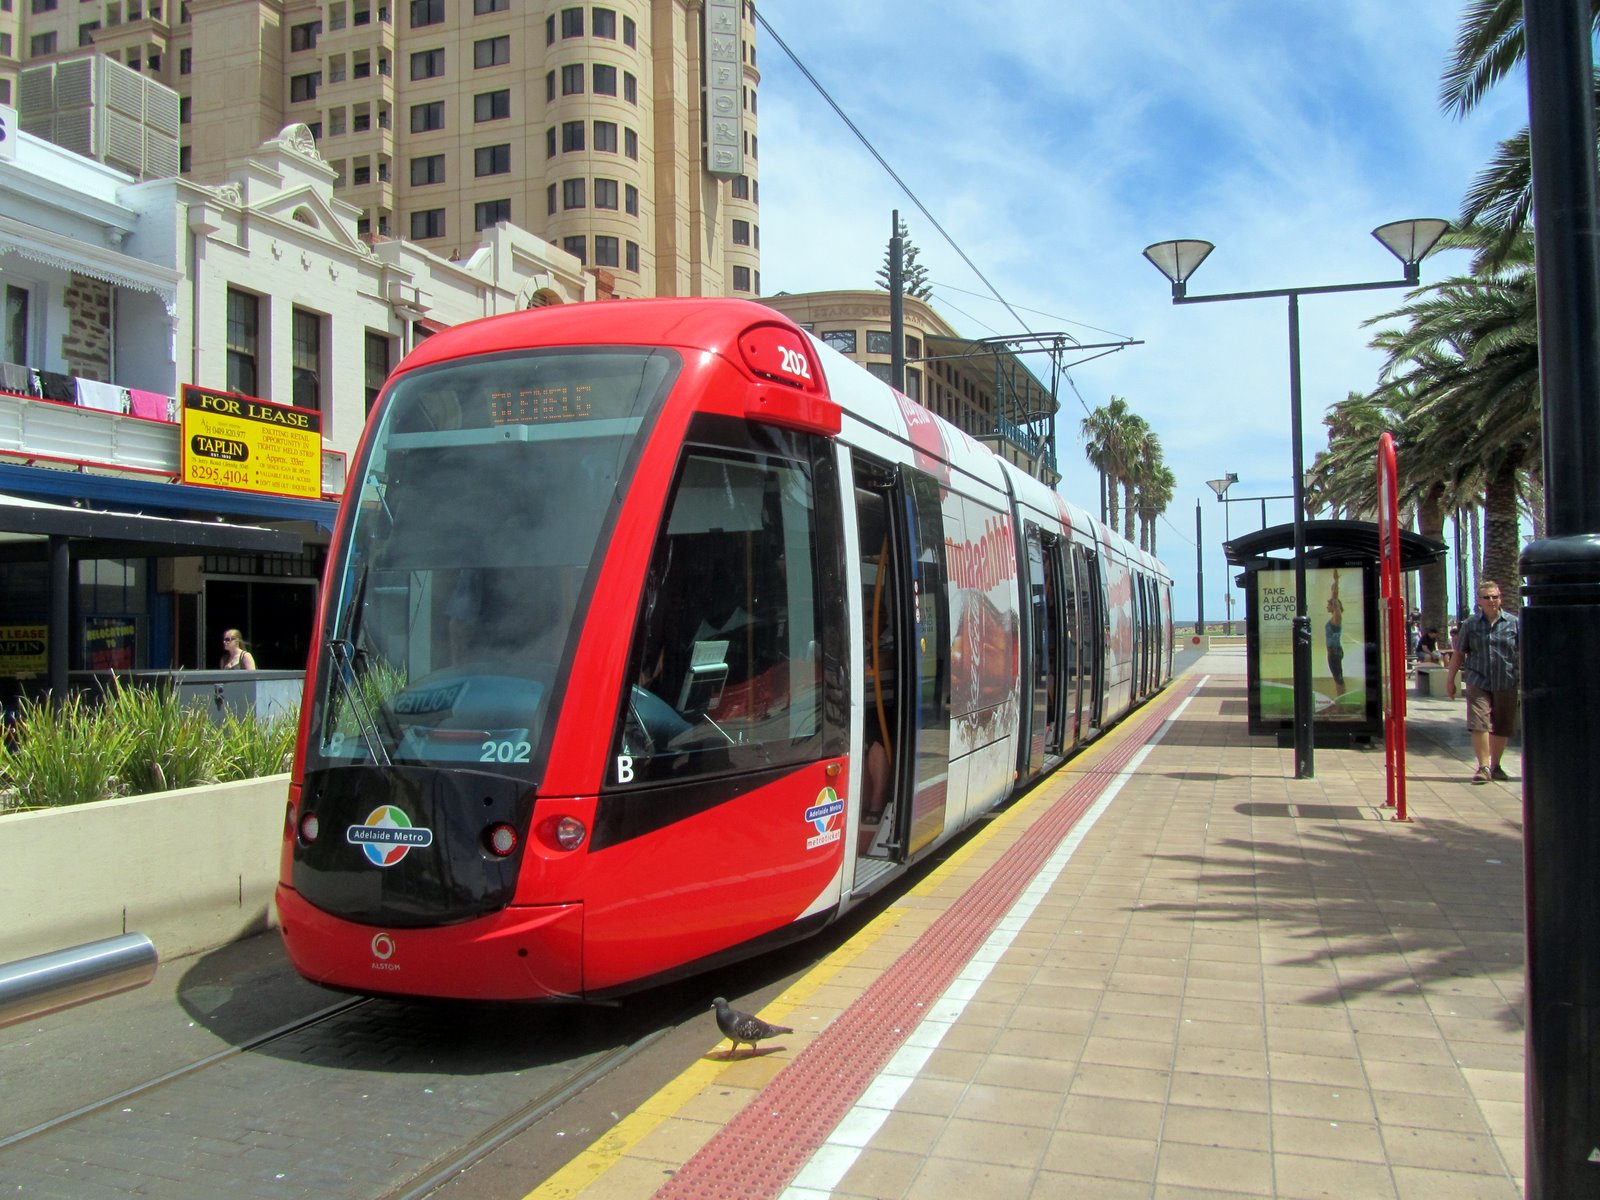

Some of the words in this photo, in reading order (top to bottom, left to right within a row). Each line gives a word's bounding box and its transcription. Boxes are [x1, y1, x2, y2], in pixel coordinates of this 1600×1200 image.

[712, 0, 736, 168] AMFORD
[813, 303, 891, 319] STAMFORD
[778, 346, 810, 379] 202
[200, 395, 242, 415] FOR
[248, 404, 309, 428] LEASE
[262, 427, 288, 438] EXCITING
[291, 432, 309, 442] RETAIL
[263, 436, 300, 447] OPPORTUNITY
[197, 437, 242, 456] TAPLIN
[257, 443, 280, 452] TIGHTLY
[283, 448, 298, 456] HELD
[300, 450, 315, 458] STRIP
[266, 454, 287, 464] Approx.
[191, 465, 248, 484] 8295.4104
[1284, 604, 1296, 612] YO
[1263, 613, 1290, 621] BACK.
[7, 629, 45, 639] LEASE
[0, 642, 40, 652] APLIN
[479, 741, 531, 763] 202
[617, 756, 634, 783] B
[809, 807, 828, 818] Adelaide
[830, 804, 841, 812] Metro
[354, 830, 390, 840] Adelaide
[394, 832, 424, 841] Metro
[372, 963, 400, 971] ALSTOM
